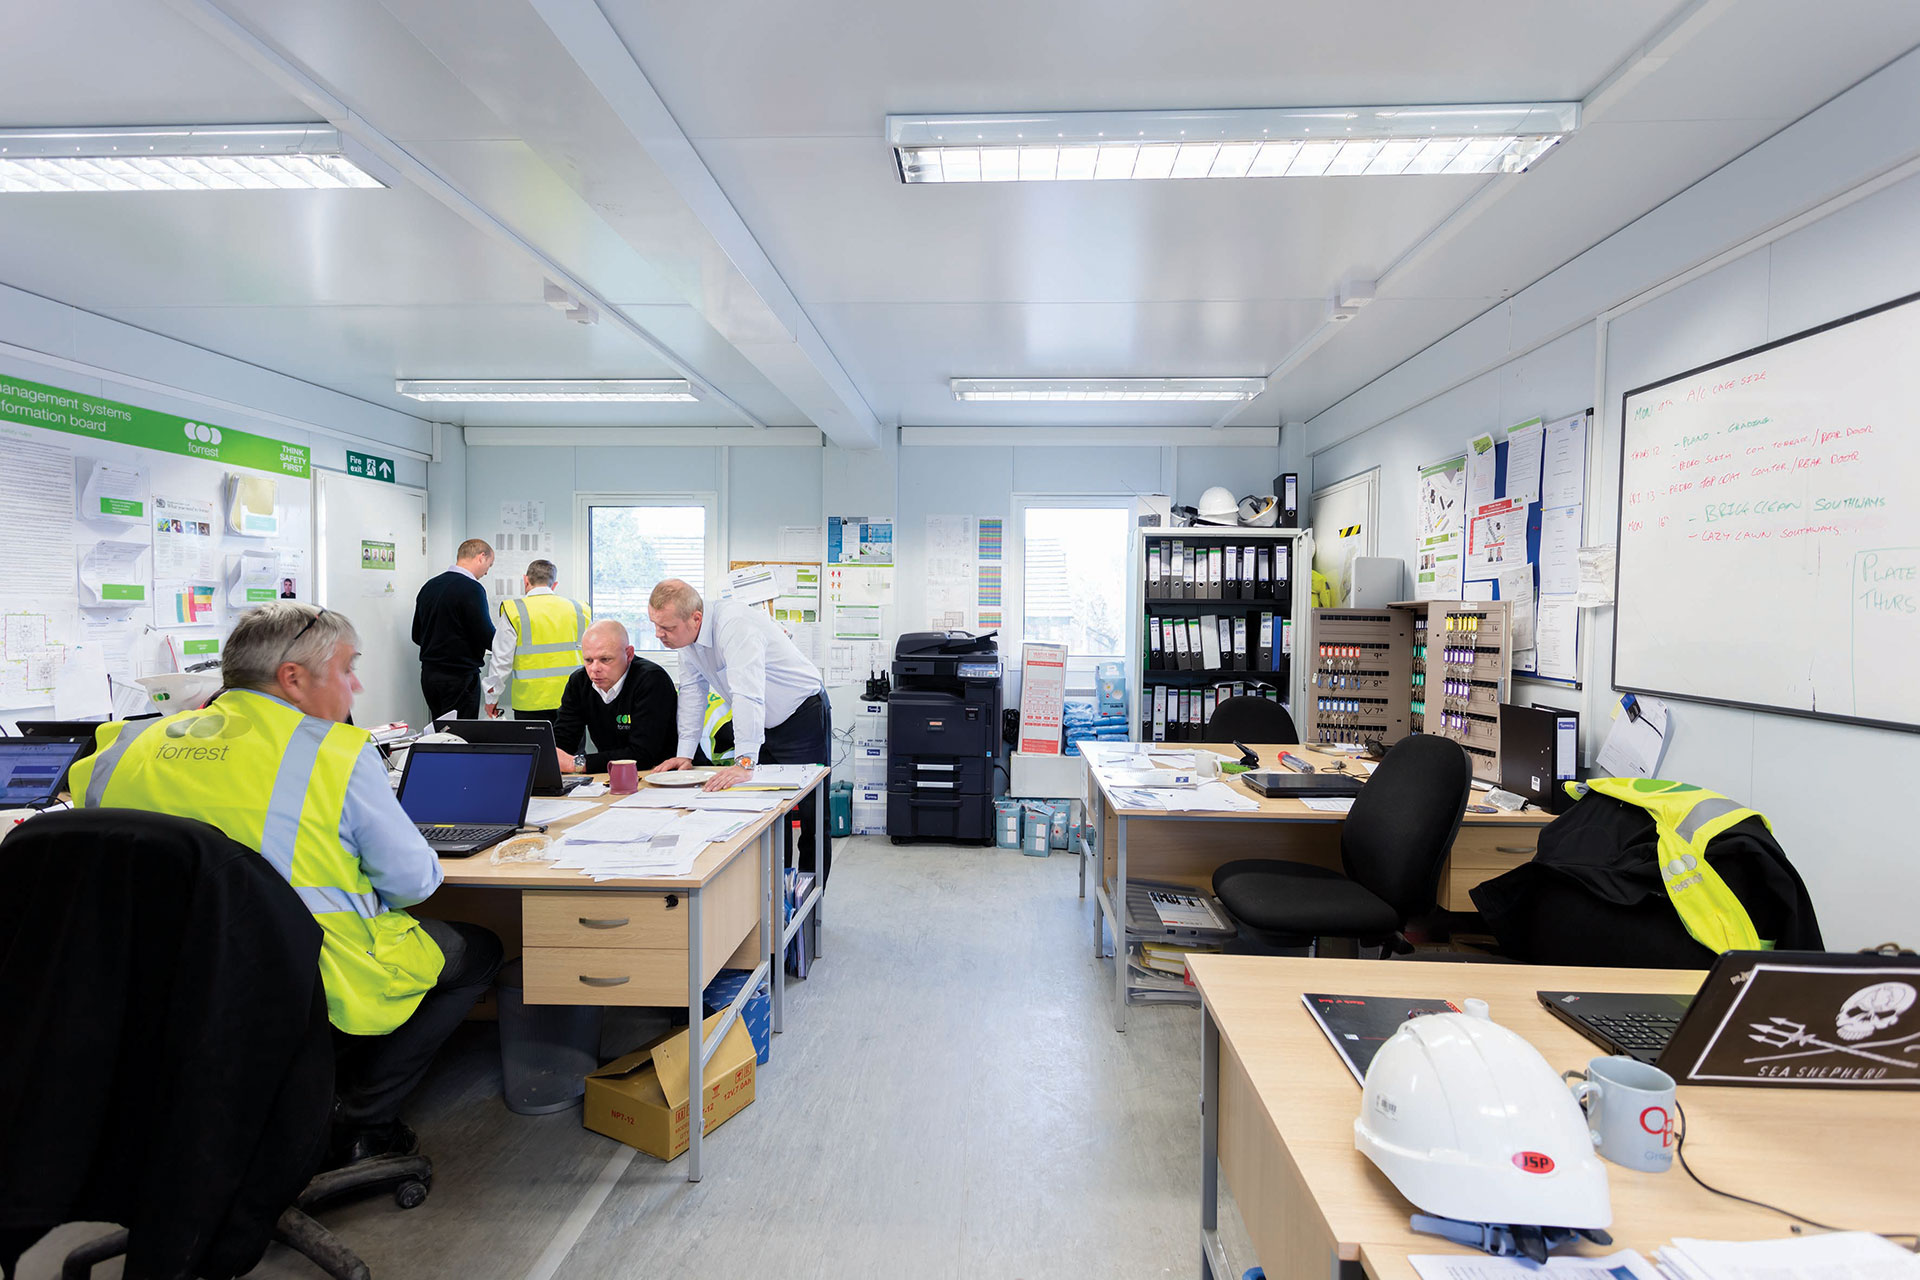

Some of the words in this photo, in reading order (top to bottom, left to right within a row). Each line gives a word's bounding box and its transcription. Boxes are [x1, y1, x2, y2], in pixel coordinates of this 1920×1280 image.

[0, 384, 79, 410] anagement
[82, 402, 132, 421] systems
[0, 400, 66, 424] formation
[70, 414, 107, 432] board
[188, 441, 219, 458] forrest
[282, 445, 305, 457] THINK
[279, 453, 307, 466] SAFETY
[350, 455, 362, 465] Fire
[282, 462, 304, 473] FIRST
[350, 464, 362, 474] exit
[156, 743, 229, 761] forrest
[1757, 1065, 1791, 1078] SEA
[1796, 1066, 1888, 1079] SHEPHERD
[1523, 1155, 1549, 1170] JSP
